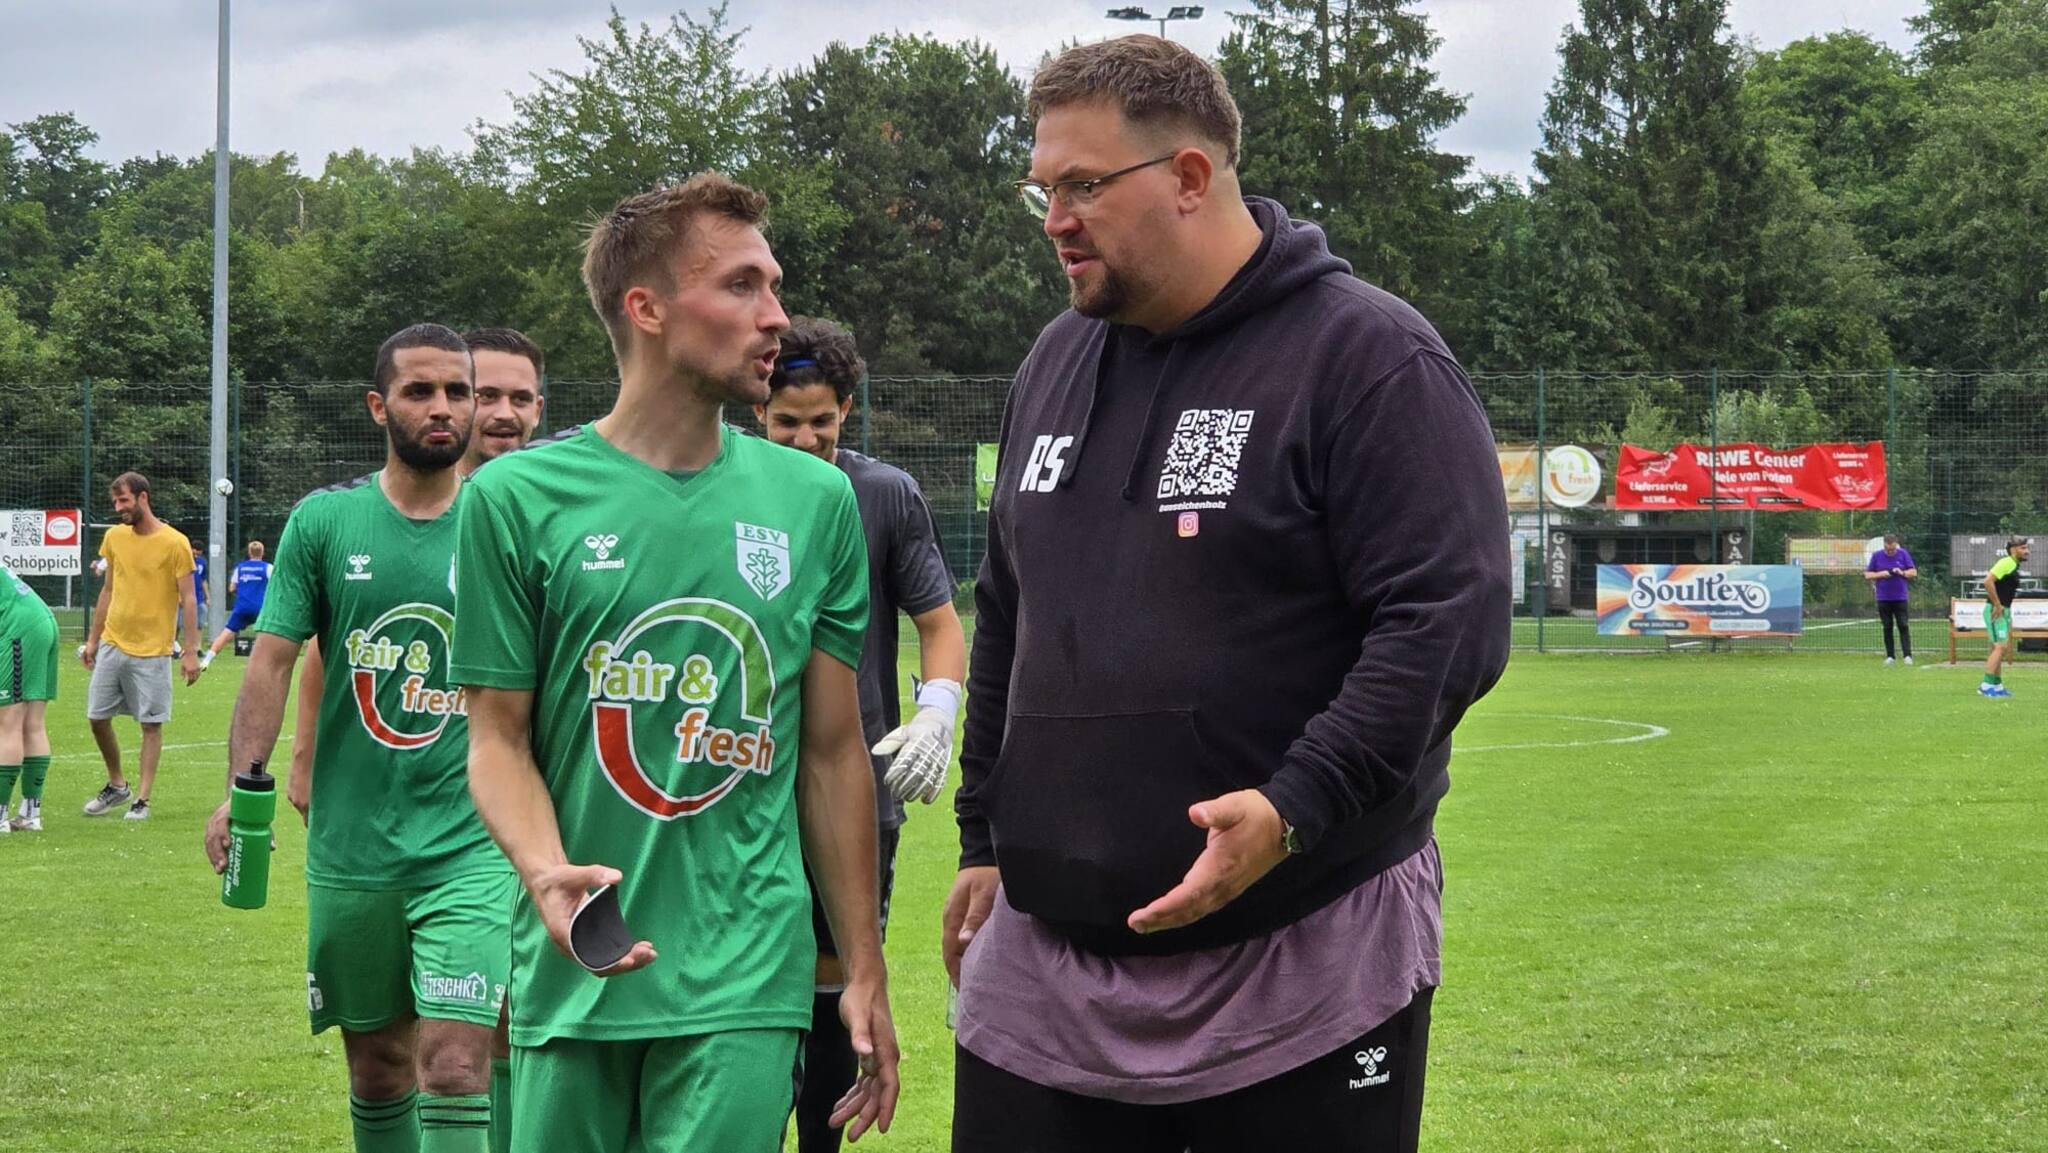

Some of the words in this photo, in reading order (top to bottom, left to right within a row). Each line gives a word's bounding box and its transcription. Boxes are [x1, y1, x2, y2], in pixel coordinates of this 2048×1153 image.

[1019, 434, 1074, 492] RS
[1696, 449, 1751, 467] REWE
[1754, 450, 1806, 468] Center
[1629, 481, 1689, 492] Lieferservice
[1740, 471, 1760, 482] von
[743, 527, 782, 543] ESV
[2, 554, 79, 572] Schöppich
[582, 558, 625, 571] hummel
[1551, 531, 1567, 588] GAST
[1631, 573, 1767, 609] Soultex
[346, 630, 402, 669] fair
[405, 641, 430, 673] &
[584, 641, 674, 700] fair
[678, 655, 717, 703] &
[676, 709, 774, 774] fresh
[1349, 1070, 1390, 1090] hummel
